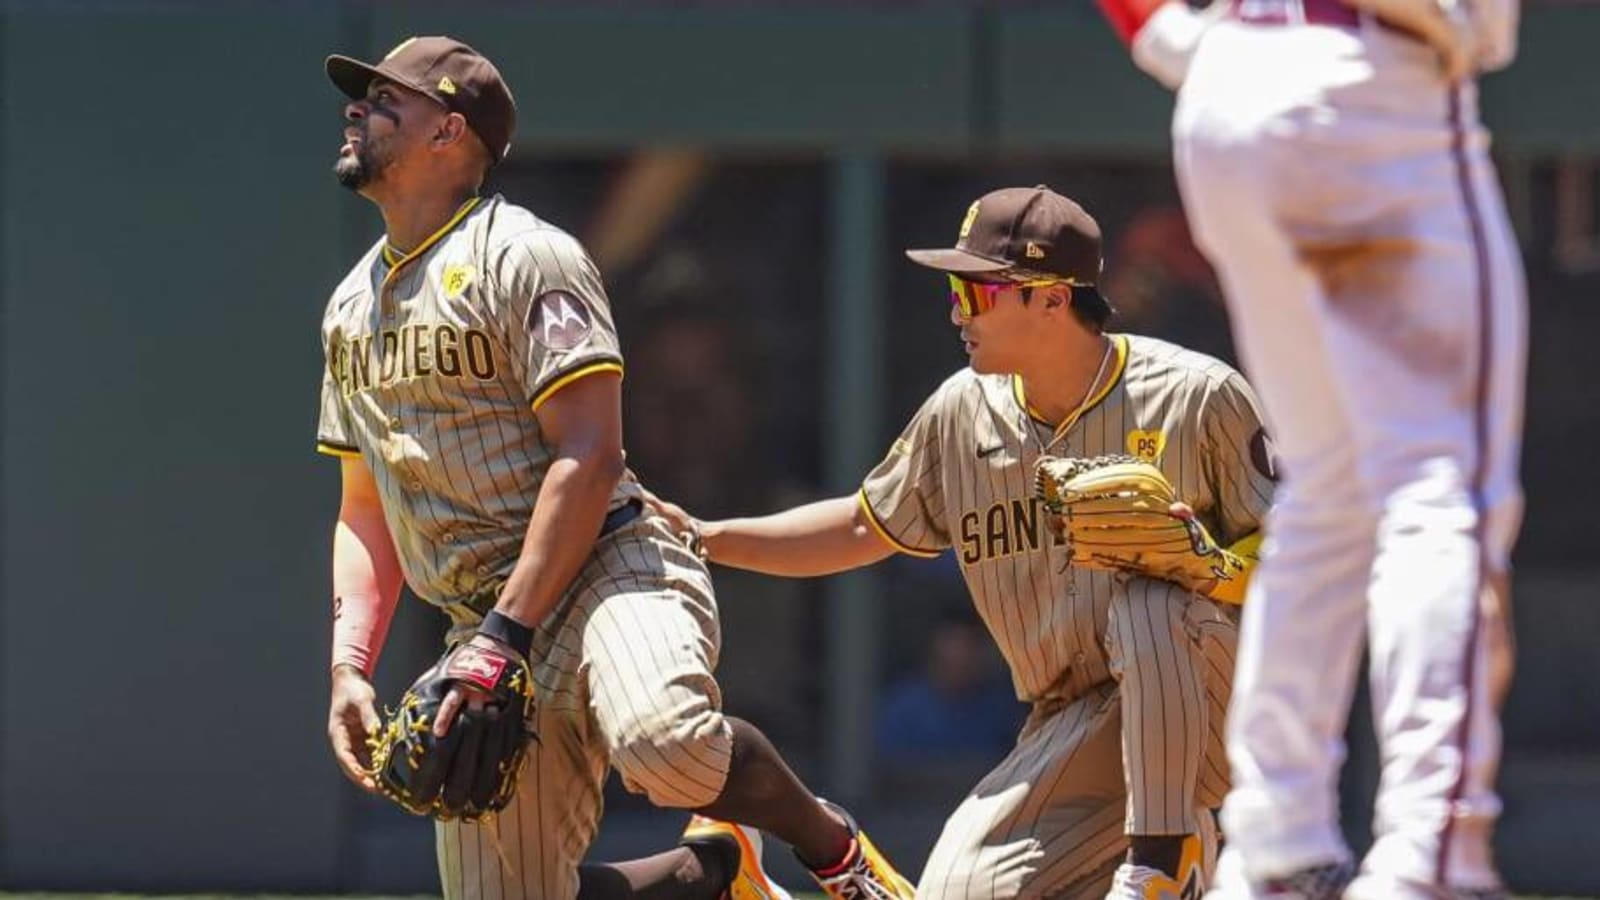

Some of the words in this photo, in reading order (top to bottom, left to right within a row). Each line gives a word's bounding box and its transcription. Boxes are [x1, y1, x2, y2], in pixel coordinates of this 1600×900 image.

[379, 323, 497, 382] DIEGO
[1137, 438, 1156, 457] PS
[960, 497, 1040, 565] SAN
